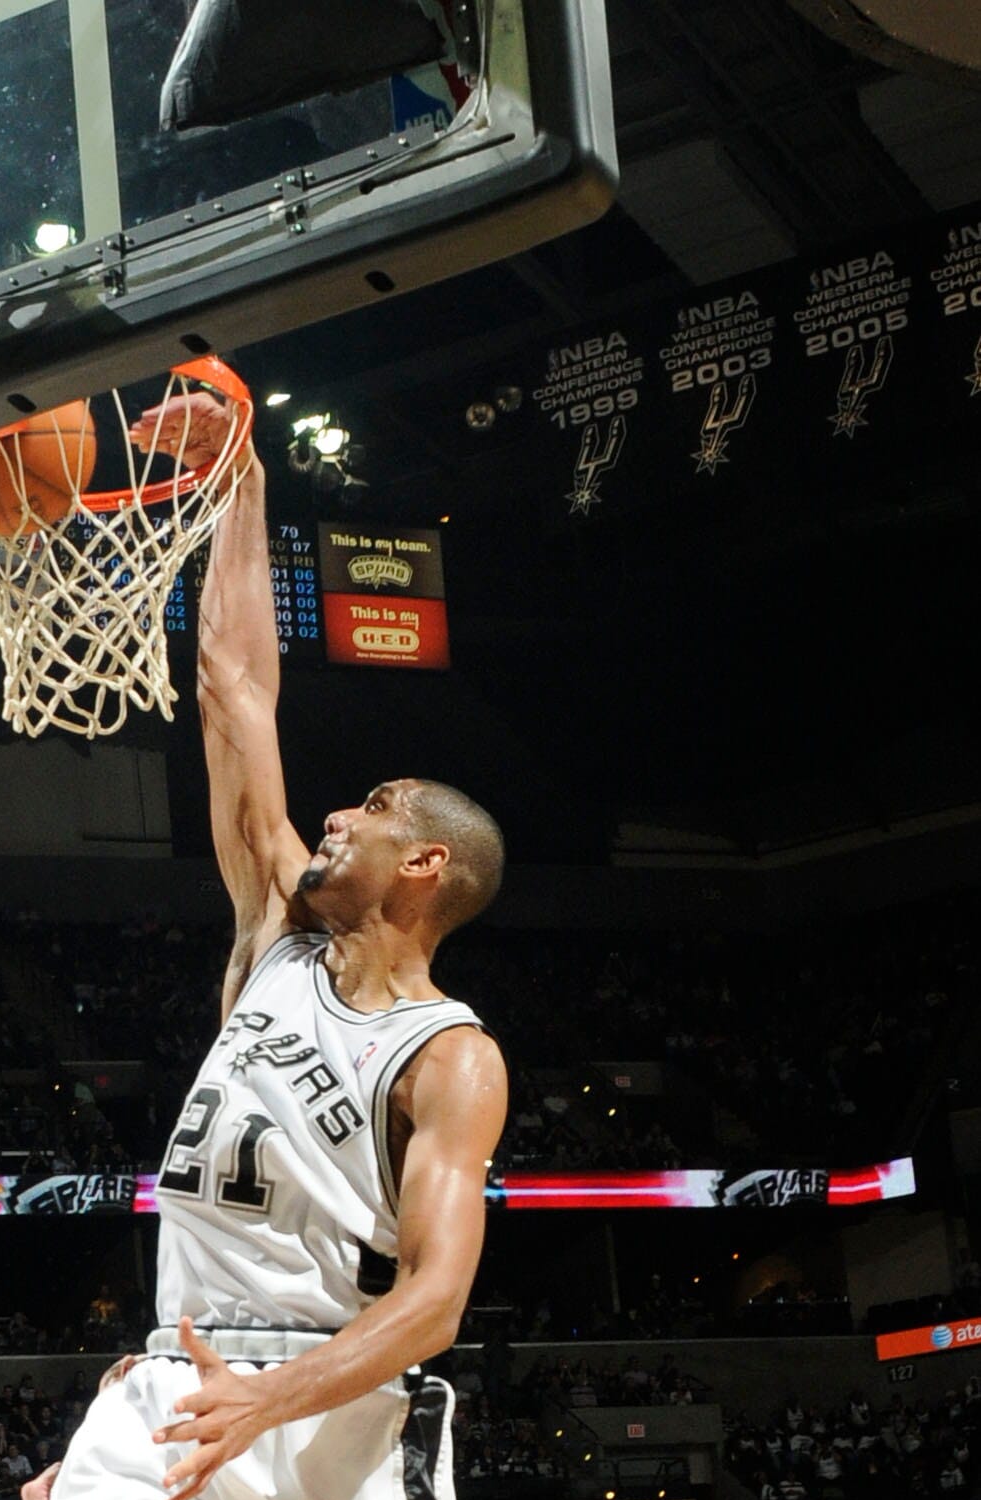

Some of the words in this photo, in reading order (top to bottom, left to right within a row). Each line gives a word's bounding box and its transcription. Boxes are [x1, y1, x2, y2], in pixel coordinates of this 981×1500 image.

[821, 250, 895, 287] NBA
[793, 276, 913, 322] CONFERENCE
[806, 269, 895, 305] WESTERN
[687, 290, 759, 325] NBA
[799, 291, 910, 334] CHAMPIONS
[659, 315, 777, 359] CONFERENCE
[671, 308, 759, 343] WESTERN
[805, 308, 909, 357] 2005
[545, 349, 628, 383] WESTERN
[559, 331, 628, 366] NBA
[665, 330, 774, 371] CHAMPIONS
[532, 356, 644, 400] CONFERENCE
[671, 347, 772, 393] 2003
[540, 370, 643, 411] CHAMPIONS
[550, 388, 639, 430] 1999
[280, 526, 299, 539] 79
[293, 542, 311, 553] 07
[330, 534, 358, 547] This
[359, 535, 373, 549] is
[375, 539, 393, 558] my
[395, 538, 432, 553] team.
[270, 567, 288, 580] 01
[295, 569, 314, 581] 06
[271, 582, 291, 594] 05
[296, 583, 315, 595] 02
[297, 597, 317, 609] 00
[298, 612, 318, 624] 04
[350, 605, 380, 619] This
[383, 607, 397, 621] is
[400, 611, 419, 631] my
[299, 626, 319, 638] 02
[157, 1081, 274, 1212] 21
[890, 1364, 914, 1381] 127
